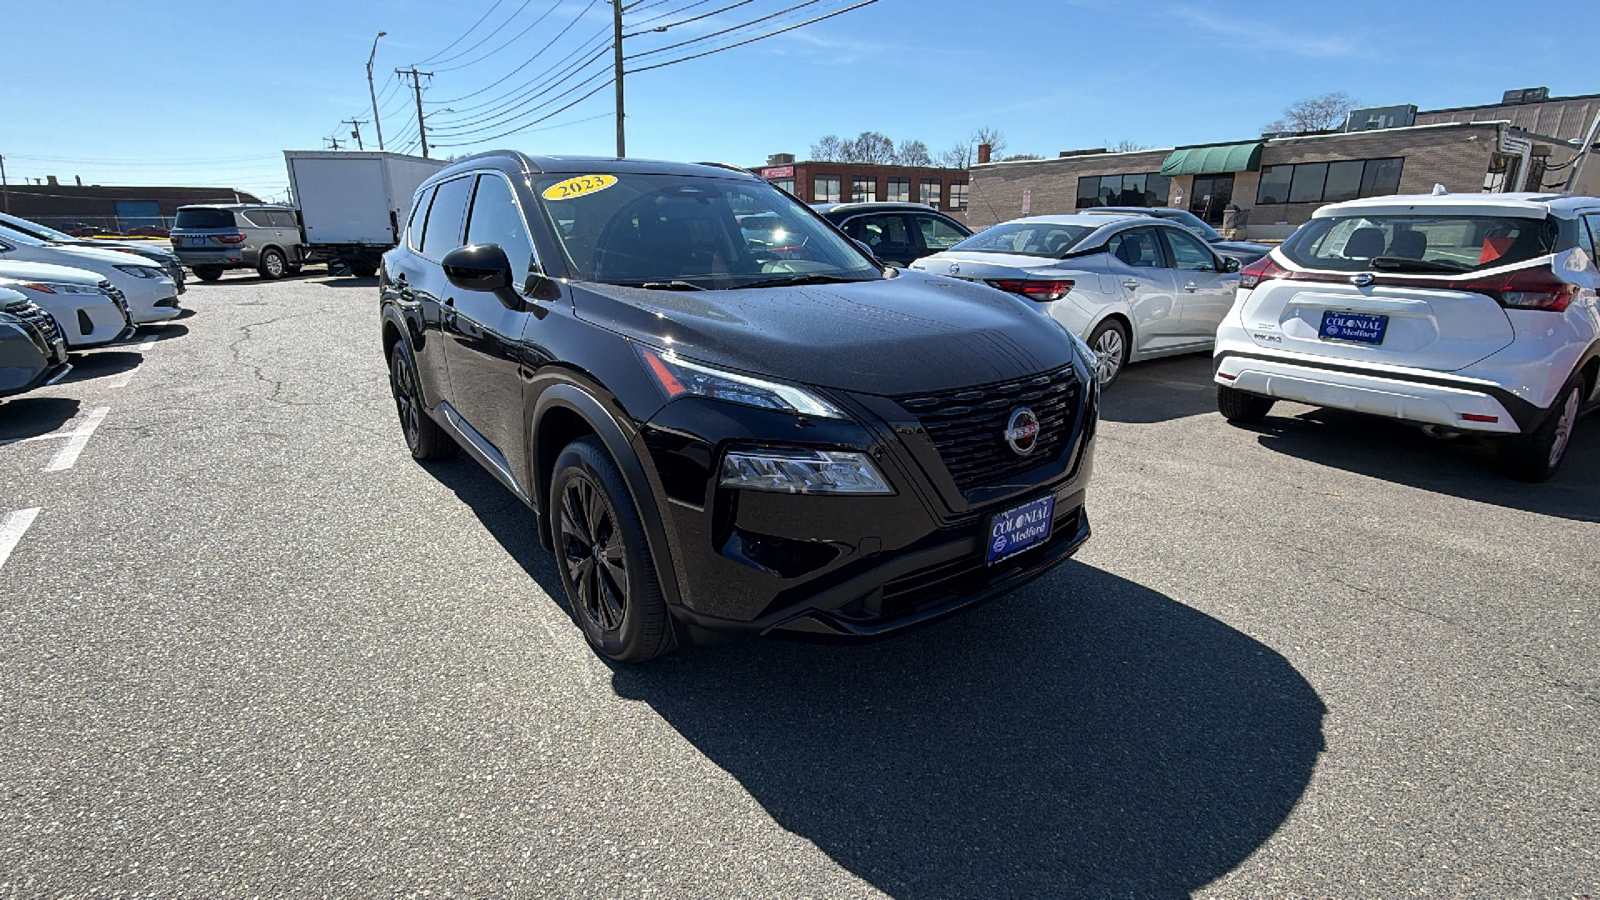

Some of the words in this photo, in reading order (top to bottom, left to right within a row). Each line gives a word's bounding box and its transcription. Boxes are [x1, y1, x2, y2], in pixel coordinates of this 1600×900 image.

[558, 176, 604, 197] 2023
[1326, 317, 1382, 331] COLONIAL
[1341, 328, 1378, 339] Medford
[992, 506, 1050, 538] COLONIAL
[1009, 521, 1046, 545] Medford
